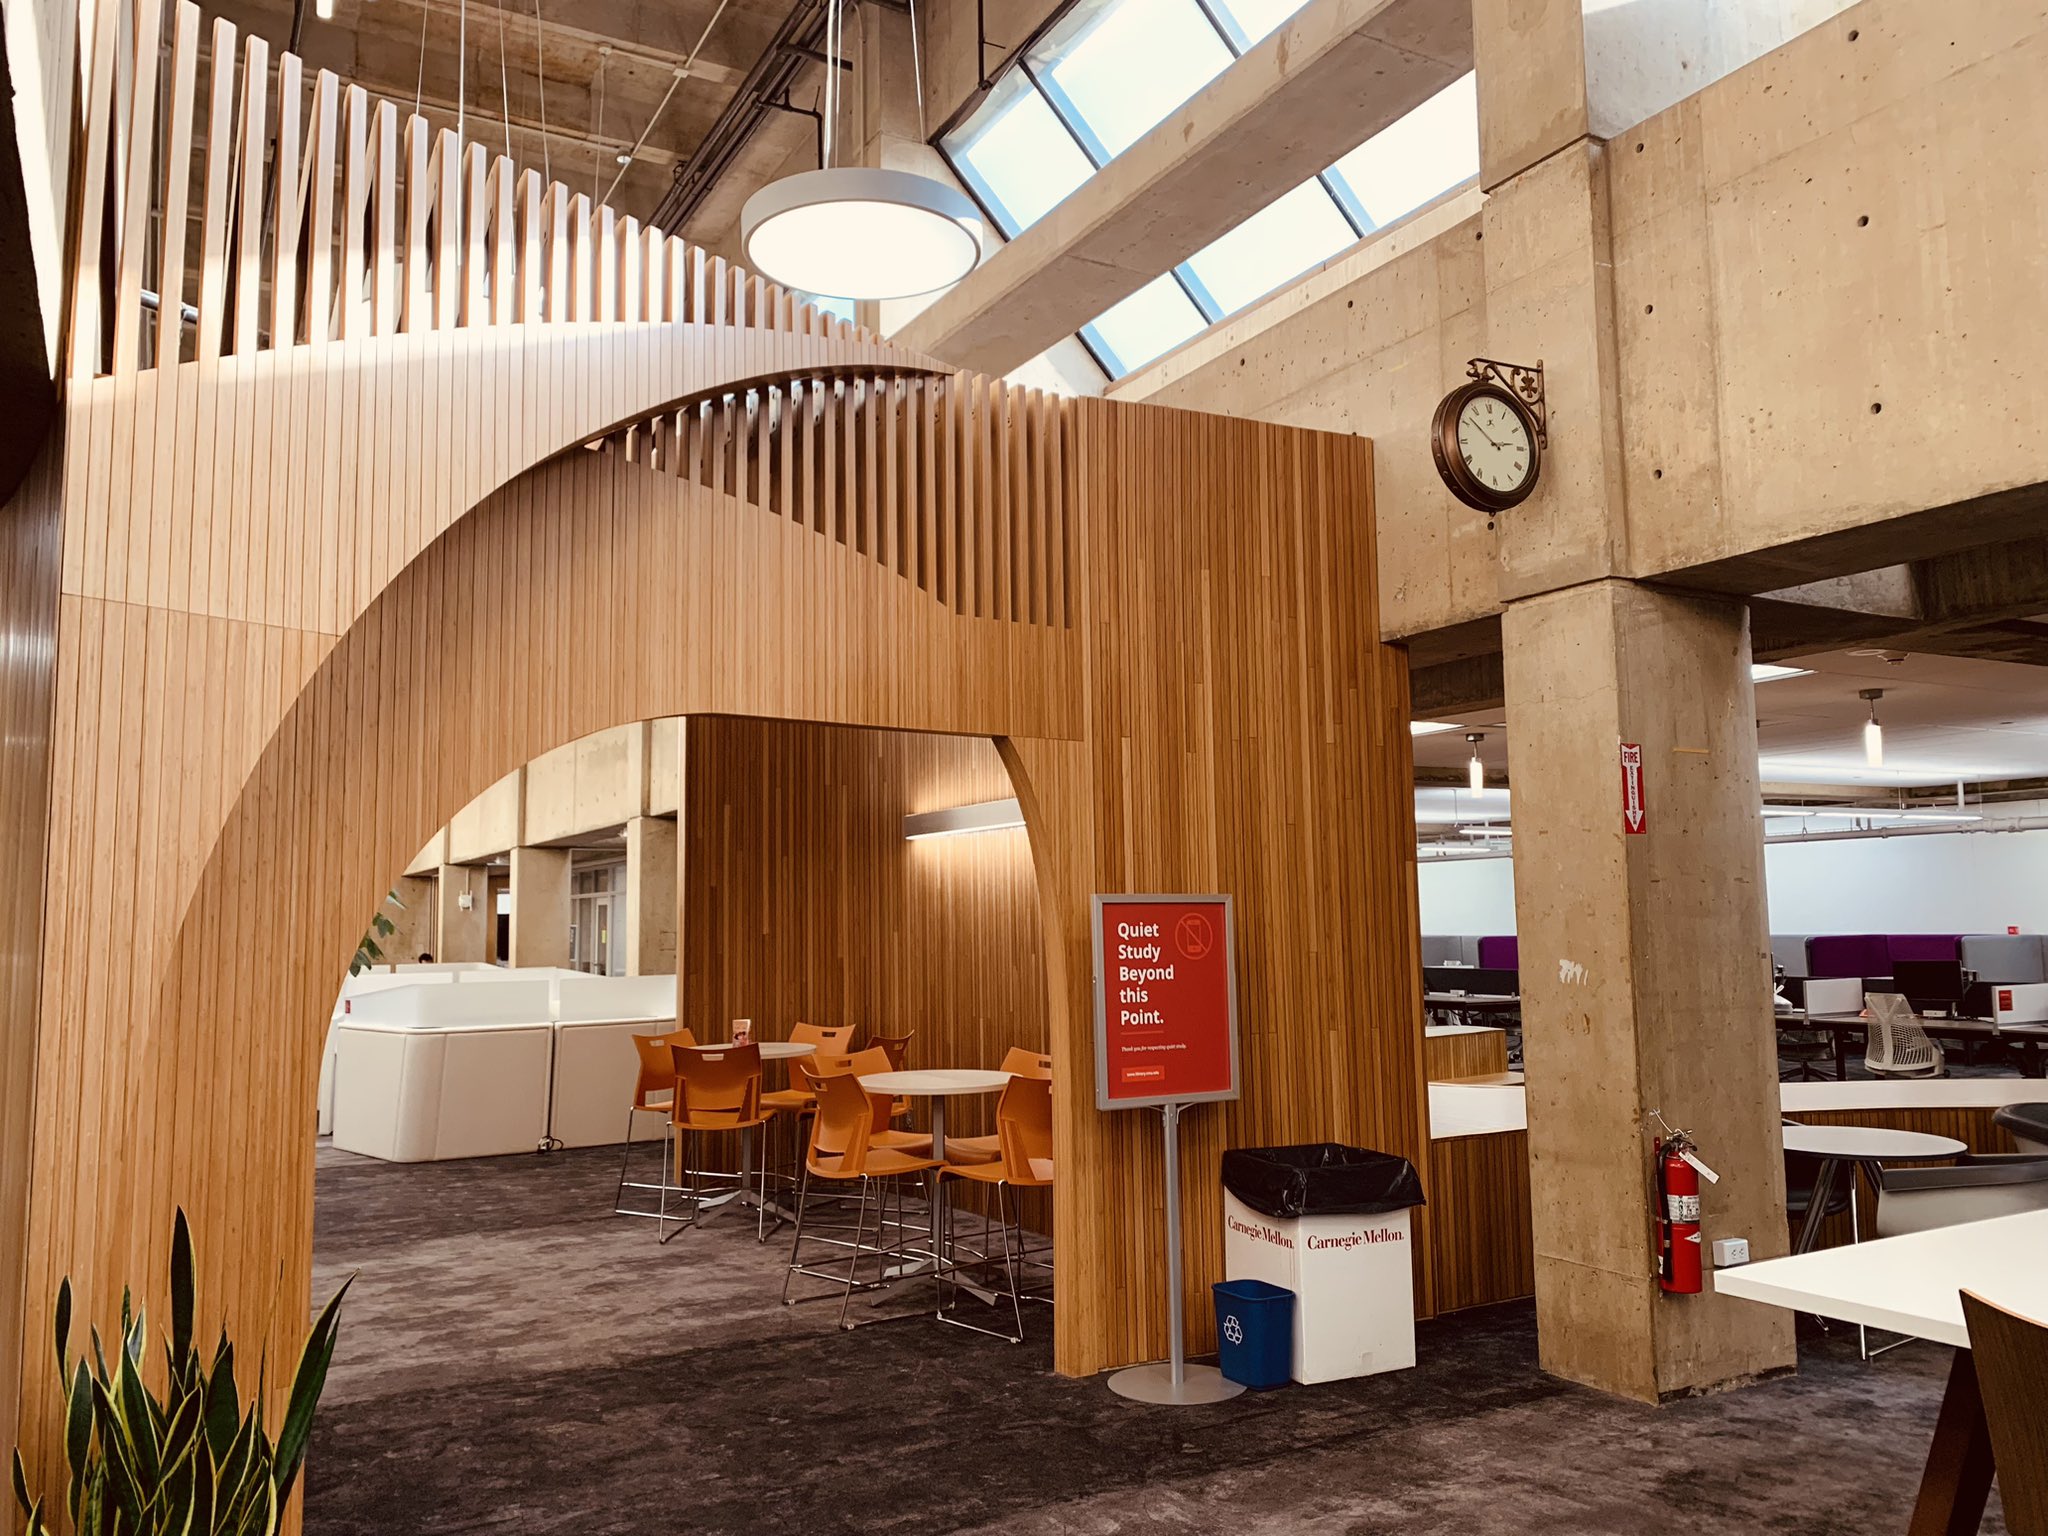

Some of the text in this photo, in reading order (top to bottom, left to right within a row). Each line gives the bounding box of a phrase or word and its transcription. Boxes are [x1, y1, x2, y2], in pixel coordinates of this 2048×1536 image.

[1623, 751, 1639, 764] FIRE
[1629, 765, 1637, 825] EXTINGUISHER
[1117, 921, 1159, 939] Quiet
[1118, 944, 1160, 962] Study
[1119, 964, 1174, 985] Beyond
[1119, 988, 1148, 1004] this
[1120, 1010, 1163, 1026] Point.
[1227, 1214, 1262, 1241] Carnegie
[1307, 1231, 1362, 1252] Carnegie
